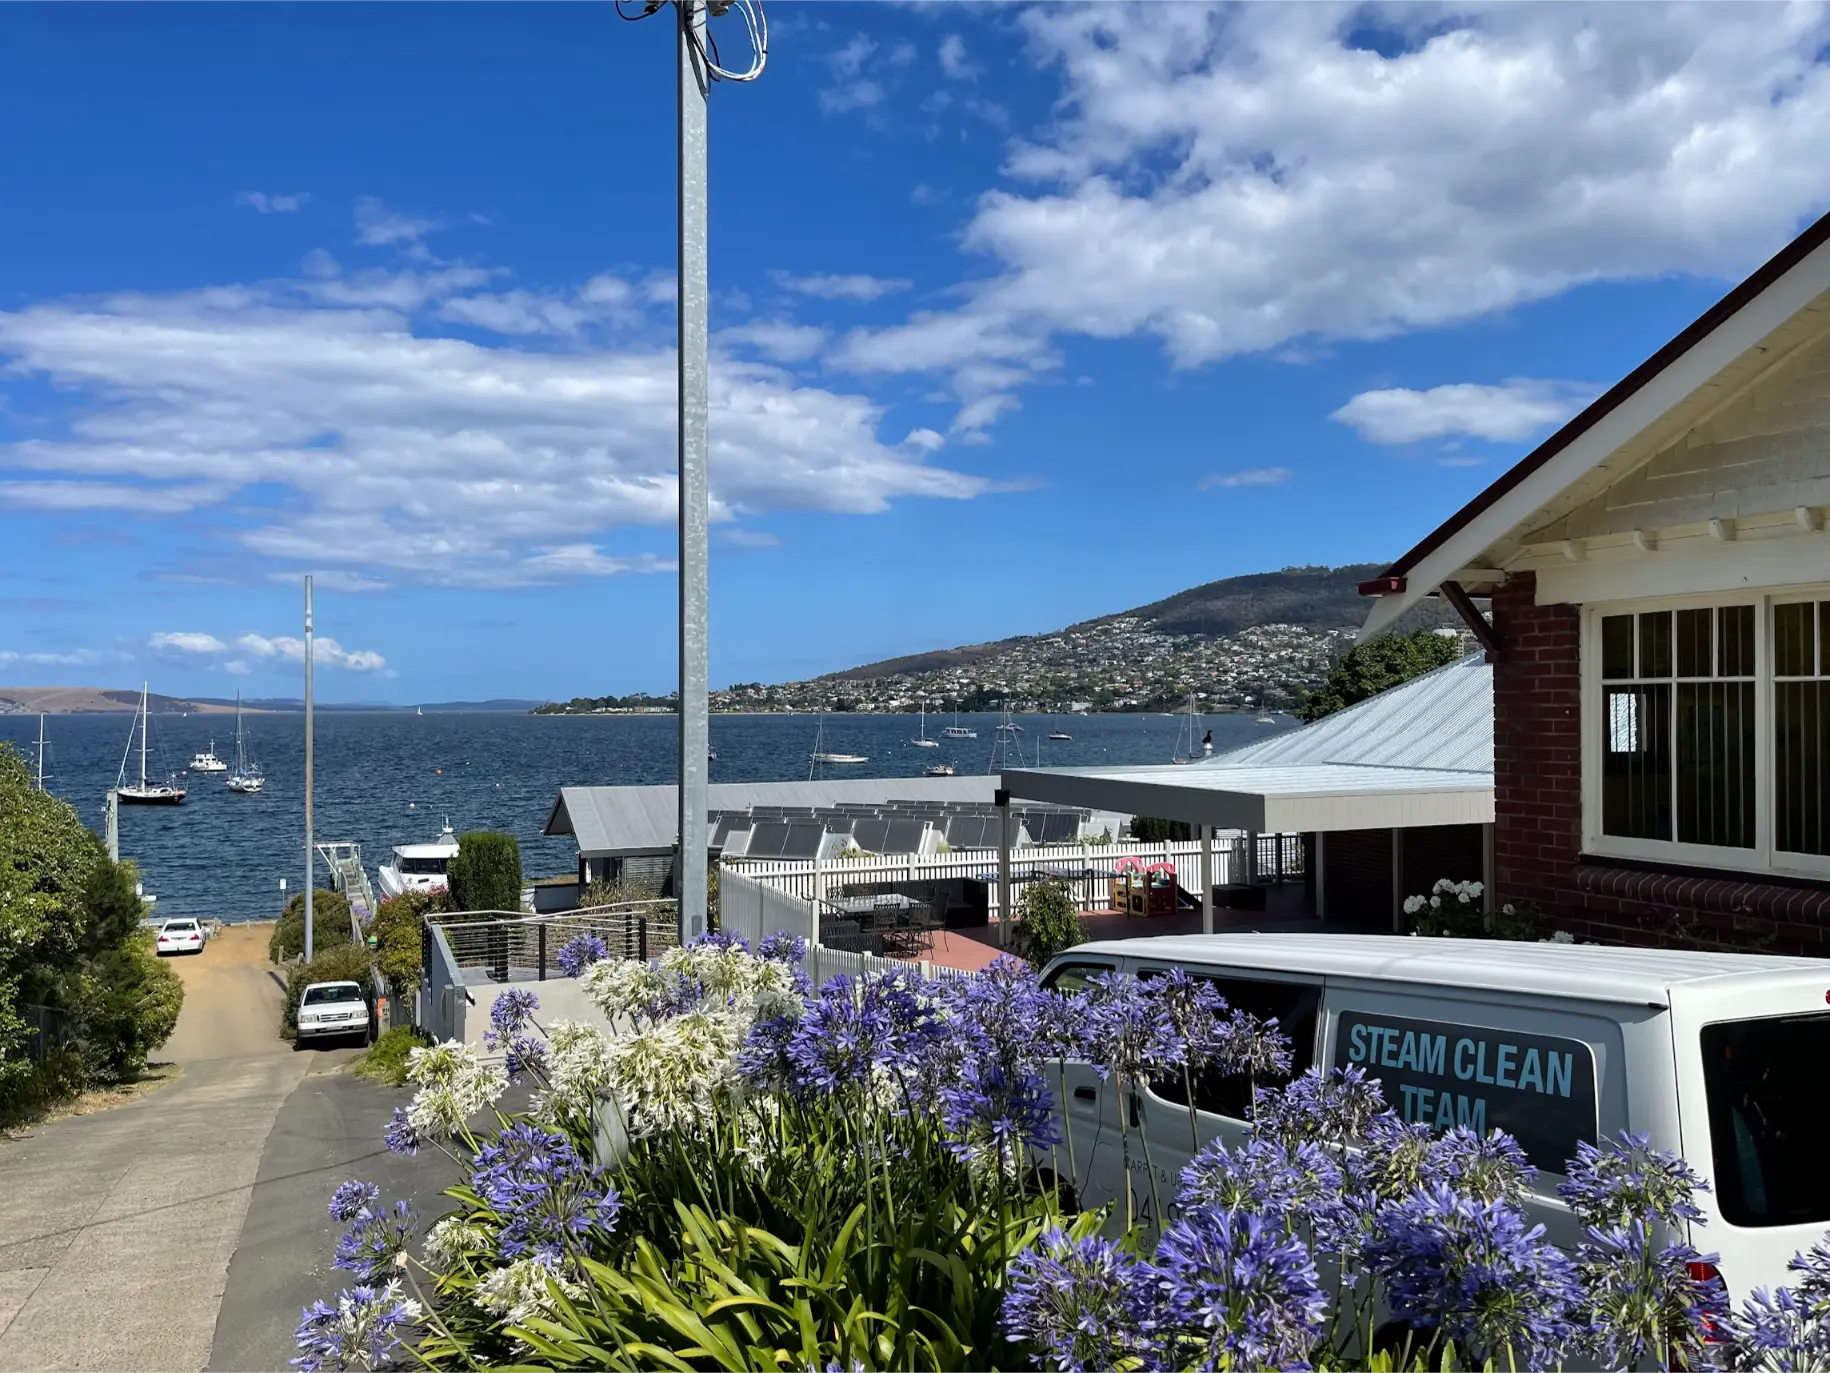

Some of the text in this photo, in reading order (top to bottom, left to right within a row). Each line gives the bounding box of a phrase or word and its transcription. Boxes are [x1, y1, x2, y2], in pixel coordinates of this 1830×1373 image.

[1349, 1024, 1573, 1097] STEAM CLEAN
[1400, 1084, 1486, 1141] TEAM
[1161, 1169, 1167, 1184] &
